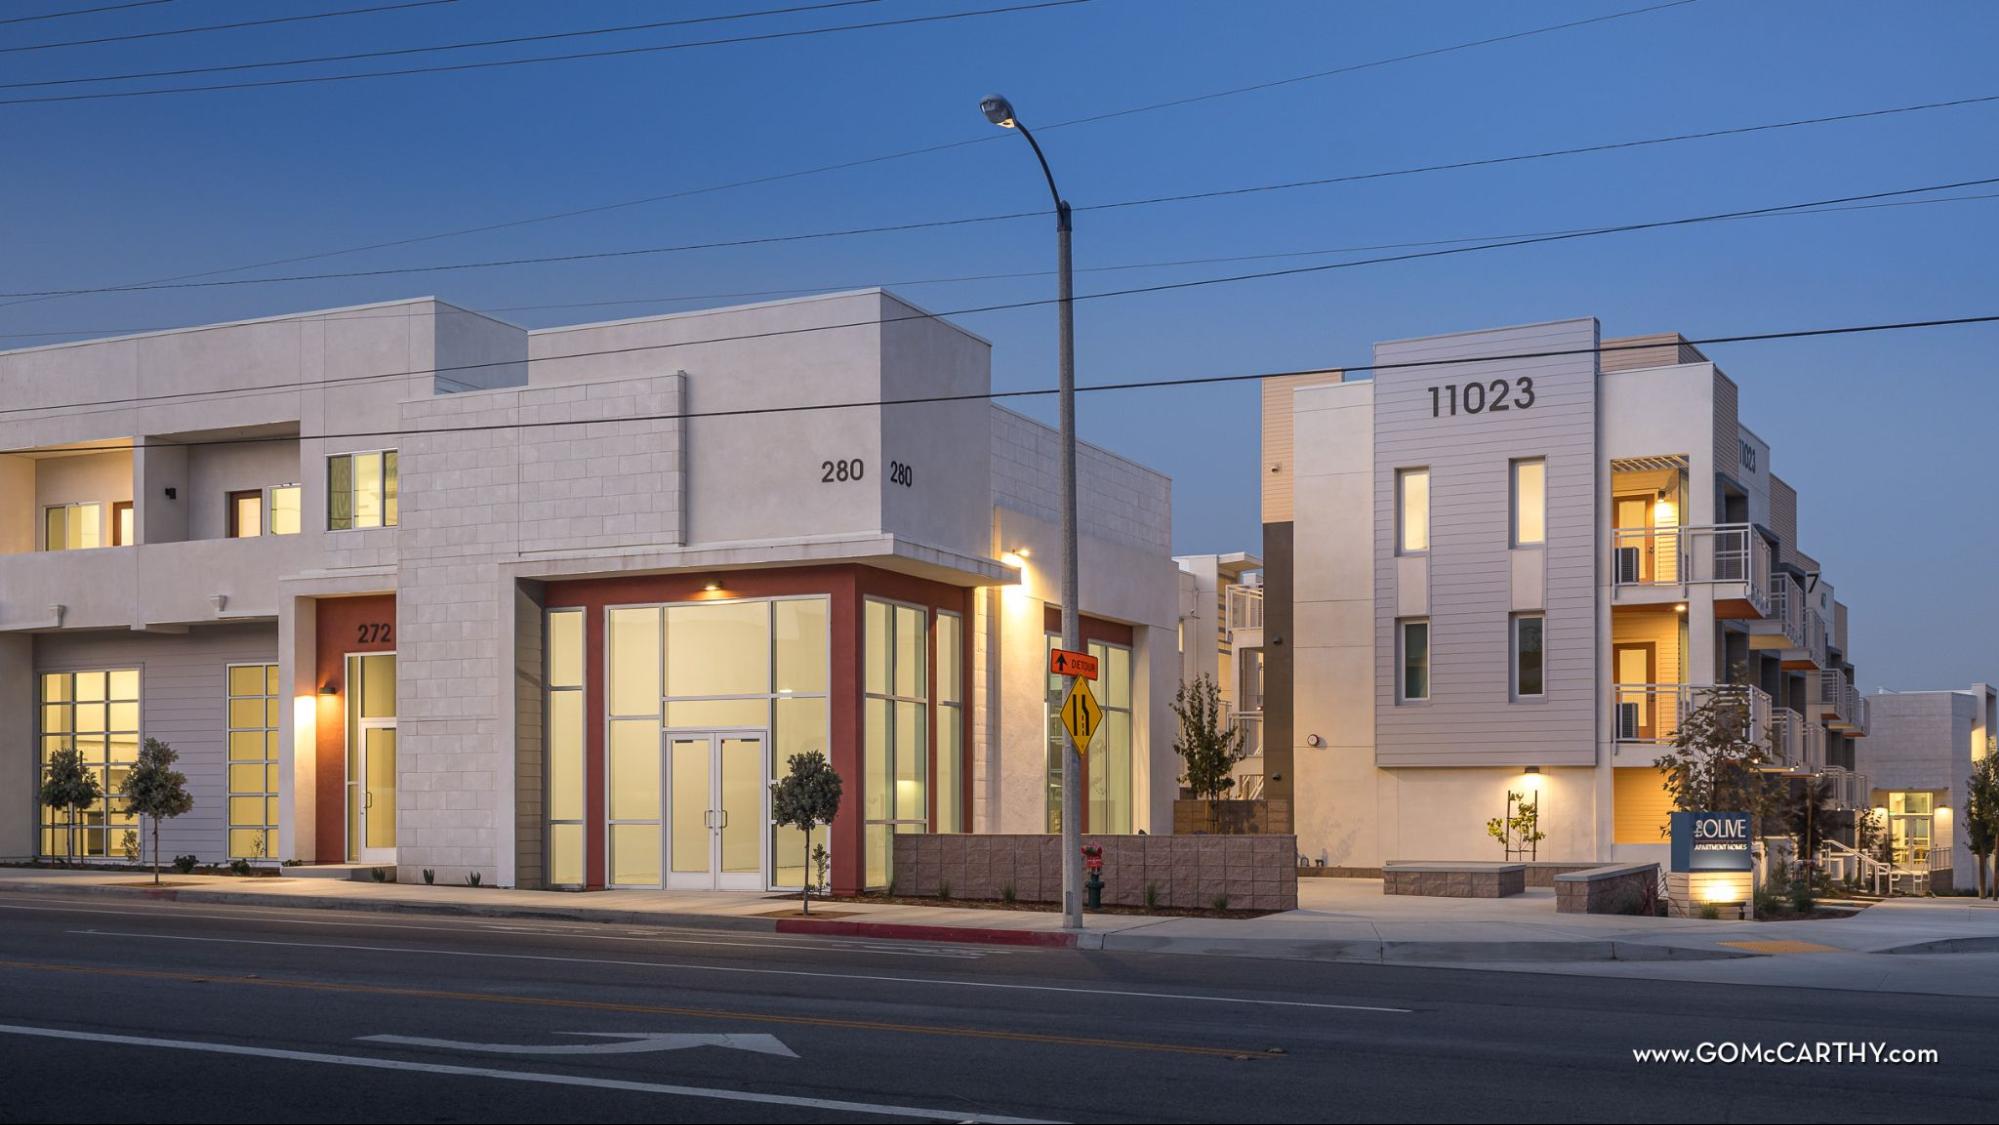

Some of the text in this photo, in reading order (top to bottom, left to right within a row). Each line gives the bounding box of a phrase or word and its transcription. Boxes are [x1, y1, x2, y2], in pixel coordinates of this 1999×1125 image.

[1428, 376, 1535, 418] 11023
[821, 458, 864, 483] 280
[890, 460, 913, 488] 280
[357, 623, 392, 644] 272
[1071, 659, 1096, 672] DETOUR
[1703, 818, 1747, 838] OLIVE
[1694, 843, 1748, 851] APARTMENT HOMES
